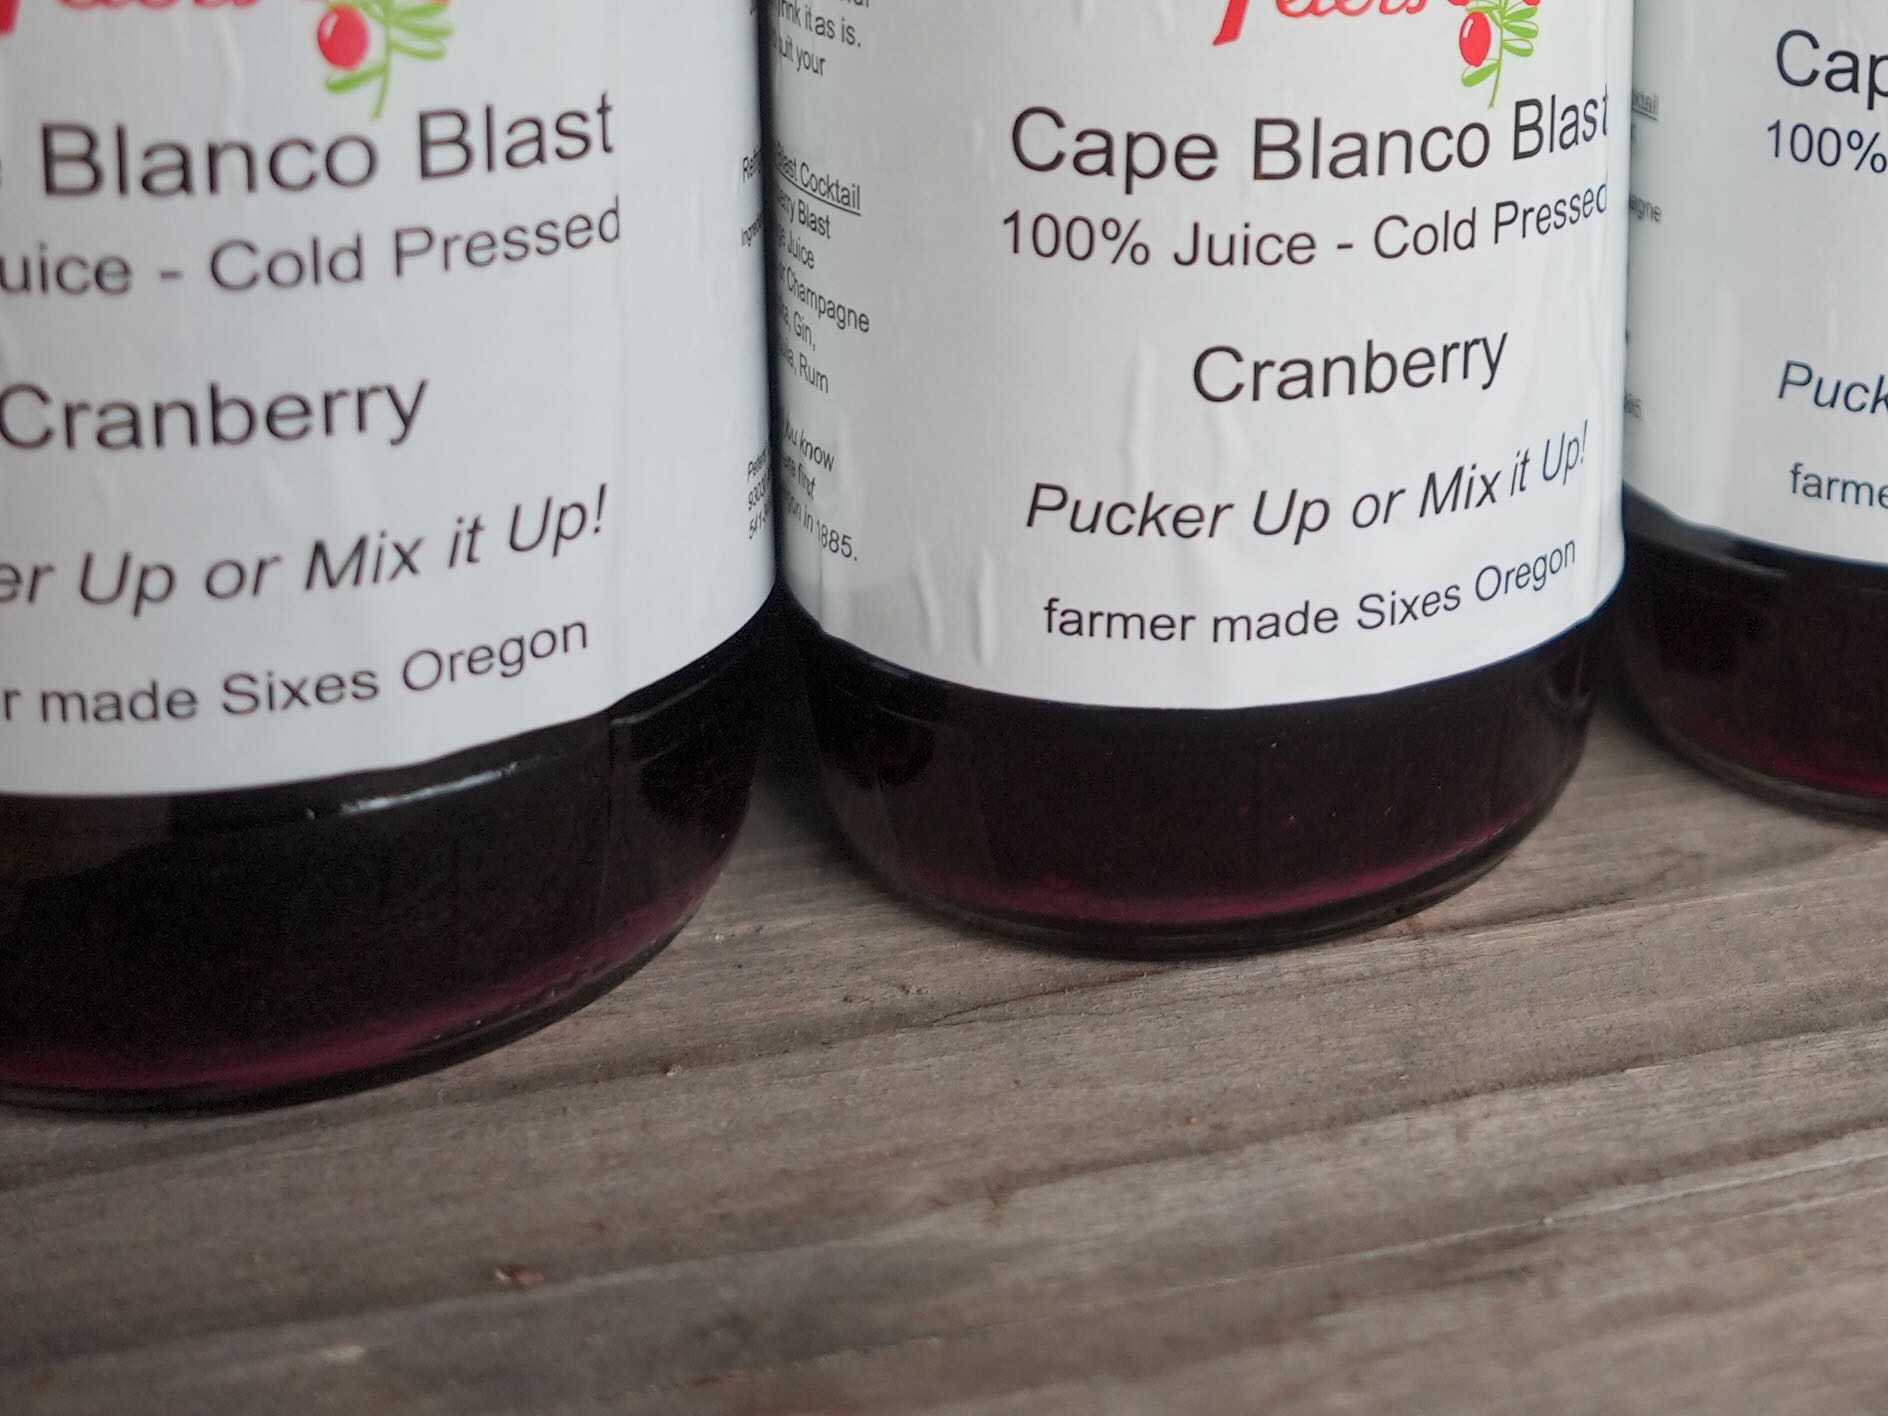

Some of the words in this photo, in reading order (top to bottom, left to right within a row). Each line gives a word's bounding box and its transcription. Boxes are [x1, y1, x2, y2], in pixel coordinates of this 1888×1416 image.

[795, 44, 827, 77] your
[814, 13, 836, 41] as
[840, 17, 862, 48] is.
[40, 122, 381, 198] Blanco
[417, 91, 614, 181] Blast
[1011, 106, 1219, 195] Cape
[1253, 117, 1490, 181] Blanco
[1512, 83, 1608, 161] Blast
[1767, 119, 1888, 174] 100%
[800, 161, 862, 214] Cocktail
[0, 243, 133, 296] uice
[160, 270, 182, 280] -
[208, 233, 364, 293] Cold
[393, 194, 620, 278] Pressed
[798, 199, 831, 240] Blast
[1003, 209, 1151, 266] 100%
[1173, 221, 1317, 267] Juice
[1374, 206, 1476, 259] Cold
[787, 231, 815, 270] Juice
[786, 265, 870, 334] Champagne
[794, 311, 816, 352] Gin,
[800, 352, 829, 395] Rum
[1192, 332, 1508, 403] Cranberry
[0, 379, 429, 451] Cranberry
[800, 427, 835, 473] know
[1026, 482, 1235, 539] Pucker
[1253, 488, 1330, 546] Up
[1352, 488, 1407, 528] or
[1419, 463, 1502, 519] Mix
[1510, 448, 1530, 496] it
[1542, 419, 1588, 485] Up!
[78, 552, 176, 619] Up
[204, 555, 282, 600] or
[304, 530, 424, 592] Mix
[448, 515, 485, 569] it
[509, 483, 607, 558] Up!
[803, 505, 814, 534] in
[816, 519, 858, 563] 1885.
[1043, 597, 1197, 642] farmer
[1213, 600, 1339, 643] made
[1357, 584, 1461, 630] Sixes
[1475, 539, 1575, 602] Oregon
[40, 679, 198, 724] made
[222, 670, 380, 716] Sixes
[401, 621, 588, 692] Oregon
